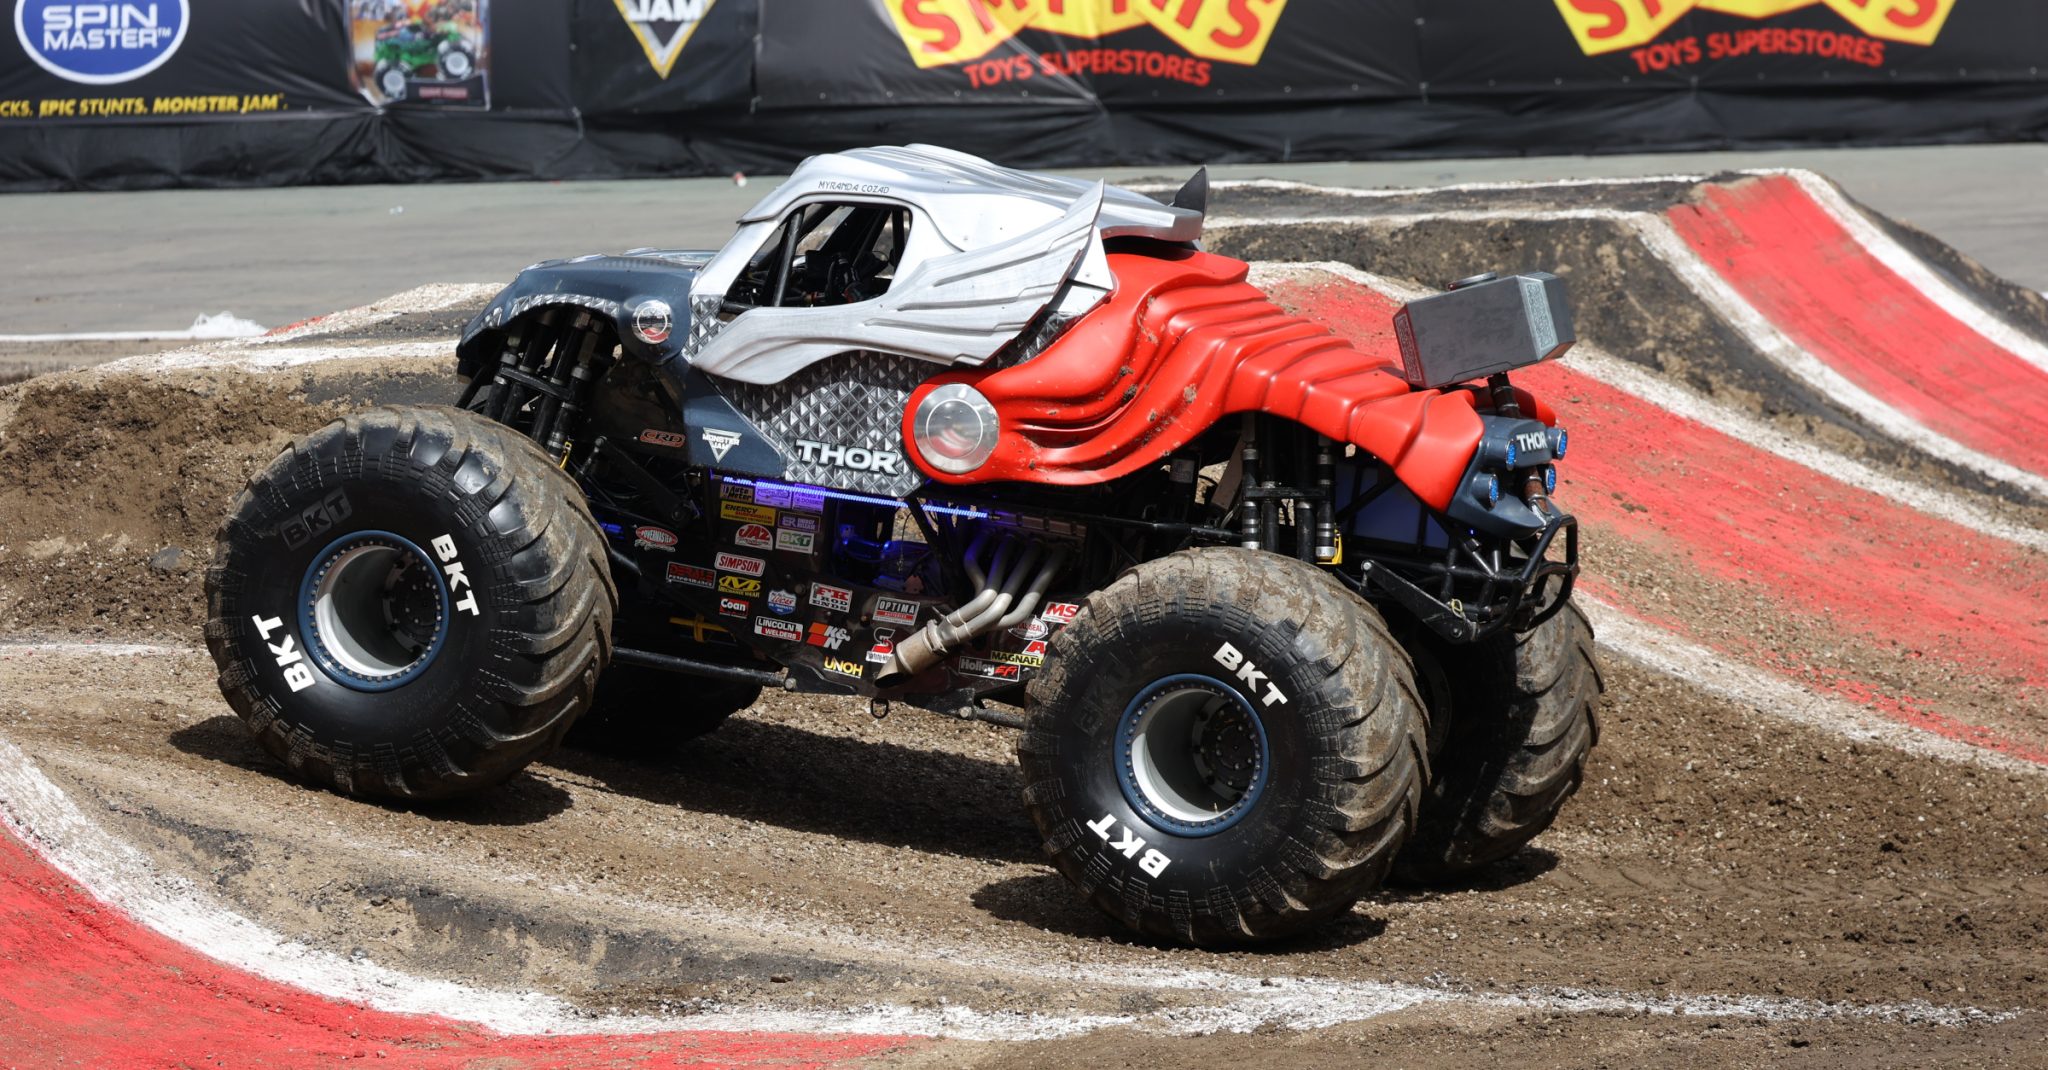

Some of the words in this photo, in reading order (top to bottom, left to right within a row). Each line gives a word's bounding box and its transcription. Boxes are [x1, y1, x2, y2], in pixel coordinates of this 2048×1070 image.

[42, 4, 158, 30] SPIN
[1631, 38, 1701, 74] TOYS
[1707, 28, 1885, 67] SUPERSTORES
[963, 54, 1033, 89] TOYS
[1039, 49, 1211, 87] SUPERSTORES
[39, 99, 76, 117] EPIC
[79, 97, 148, 117] STUNTS.
[153, 96, 240, 114] MONSTER
[818, 180, 859, 192] MYRANDA
[861, 184, 890, 194] COZAD
[702, 433, 740, 446] MONSTER
[1516, 431, 1548, 452] THOR
[796, 439, 899, 475] THOR
[282, 491, 352, 548] BKT
[738, 524, 770, 541] JAZ
[780, 531, 811, 547] BKT
[718, 555, 760, 574] SIMPSON
[430, 533, 480, 617] BKT
[720, 598, 746, 612] Coan
[811, 599, 848, 612] ENDS
[879, 600, 915, 614] OPTIMA
[757, 617, 796, 632] LINCOLN
[764, 627, 797, 641] WELDERS
[251, 614, 316, 693] BKT
[823, 656, 863, 676] UNOH
[959, 657, 995, 676] Holley
[1212, 641, 1288, 707] BKT
[1086, 813, 1172, 878] BKT
